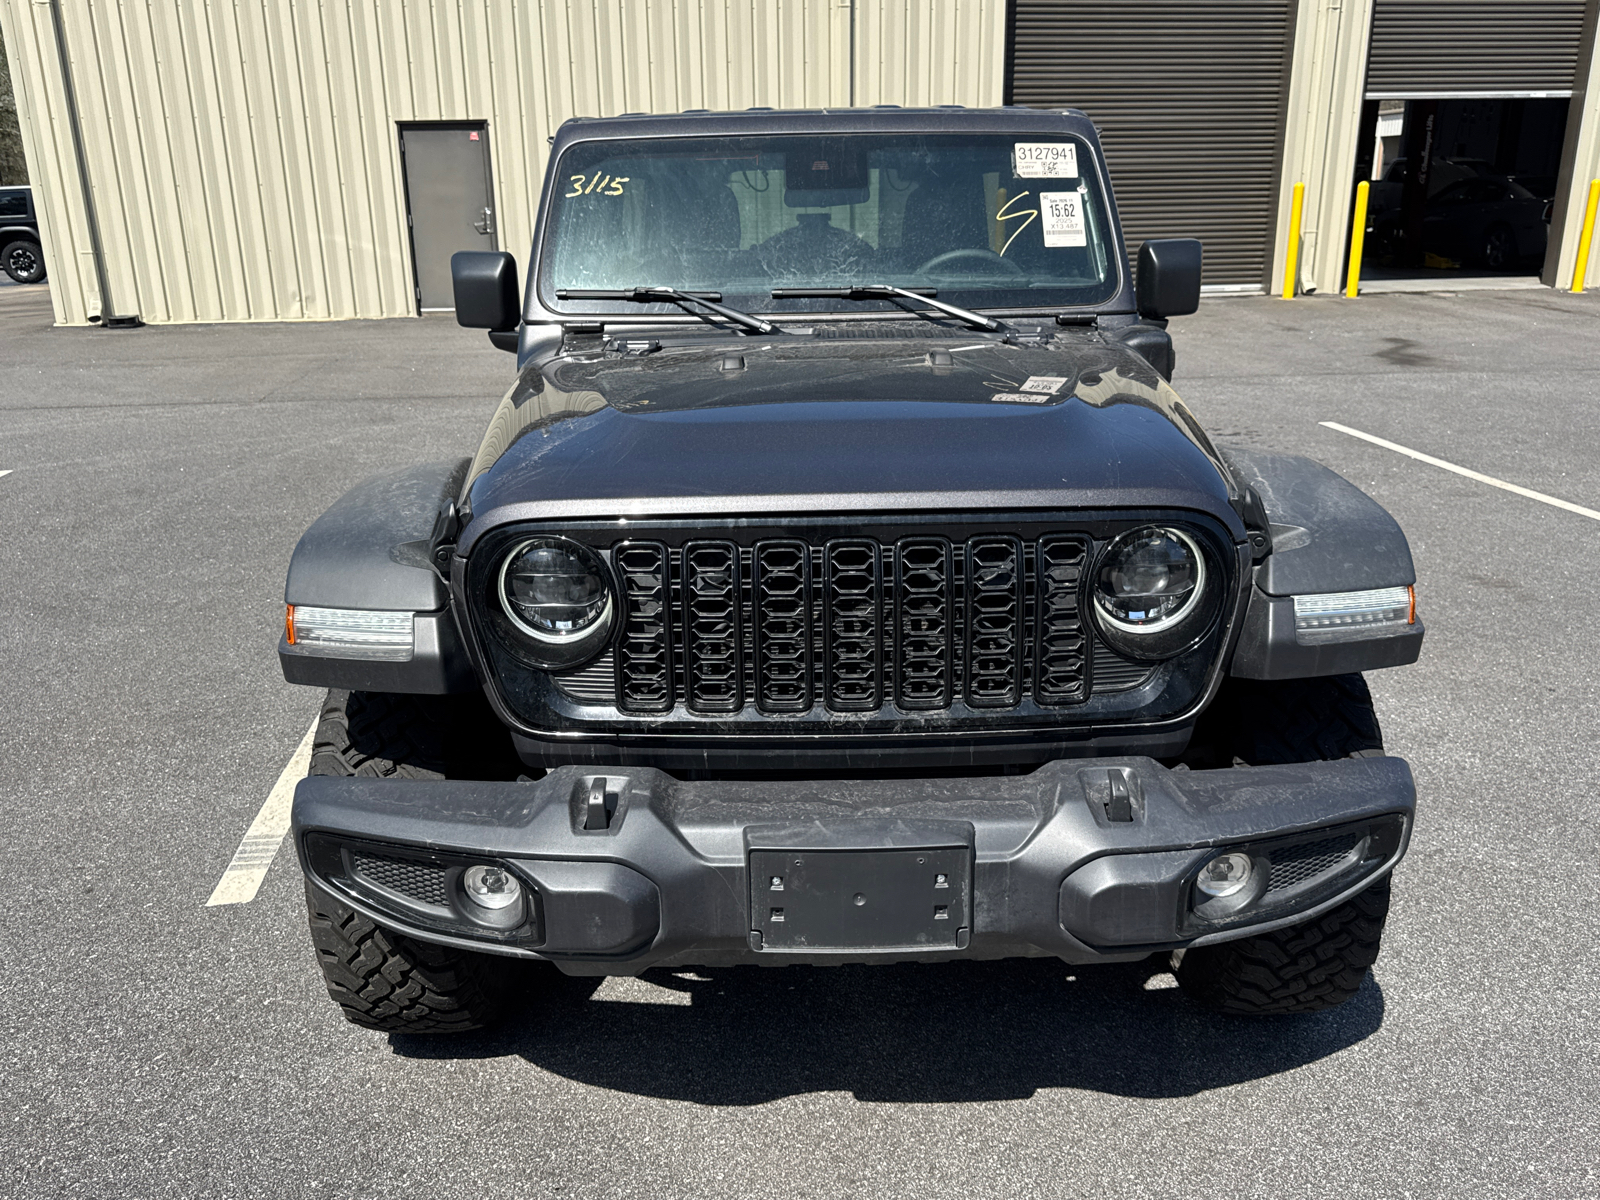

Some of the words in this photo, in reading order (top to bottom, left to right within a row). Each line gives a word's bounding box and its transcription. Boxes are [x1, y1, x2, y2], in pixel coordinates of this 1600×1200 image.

[1426, 114, 1434, 130] Lifts
[1018, 147, 1074, 160] 3127941
[1049, 203, 1075, 218] 15:62
